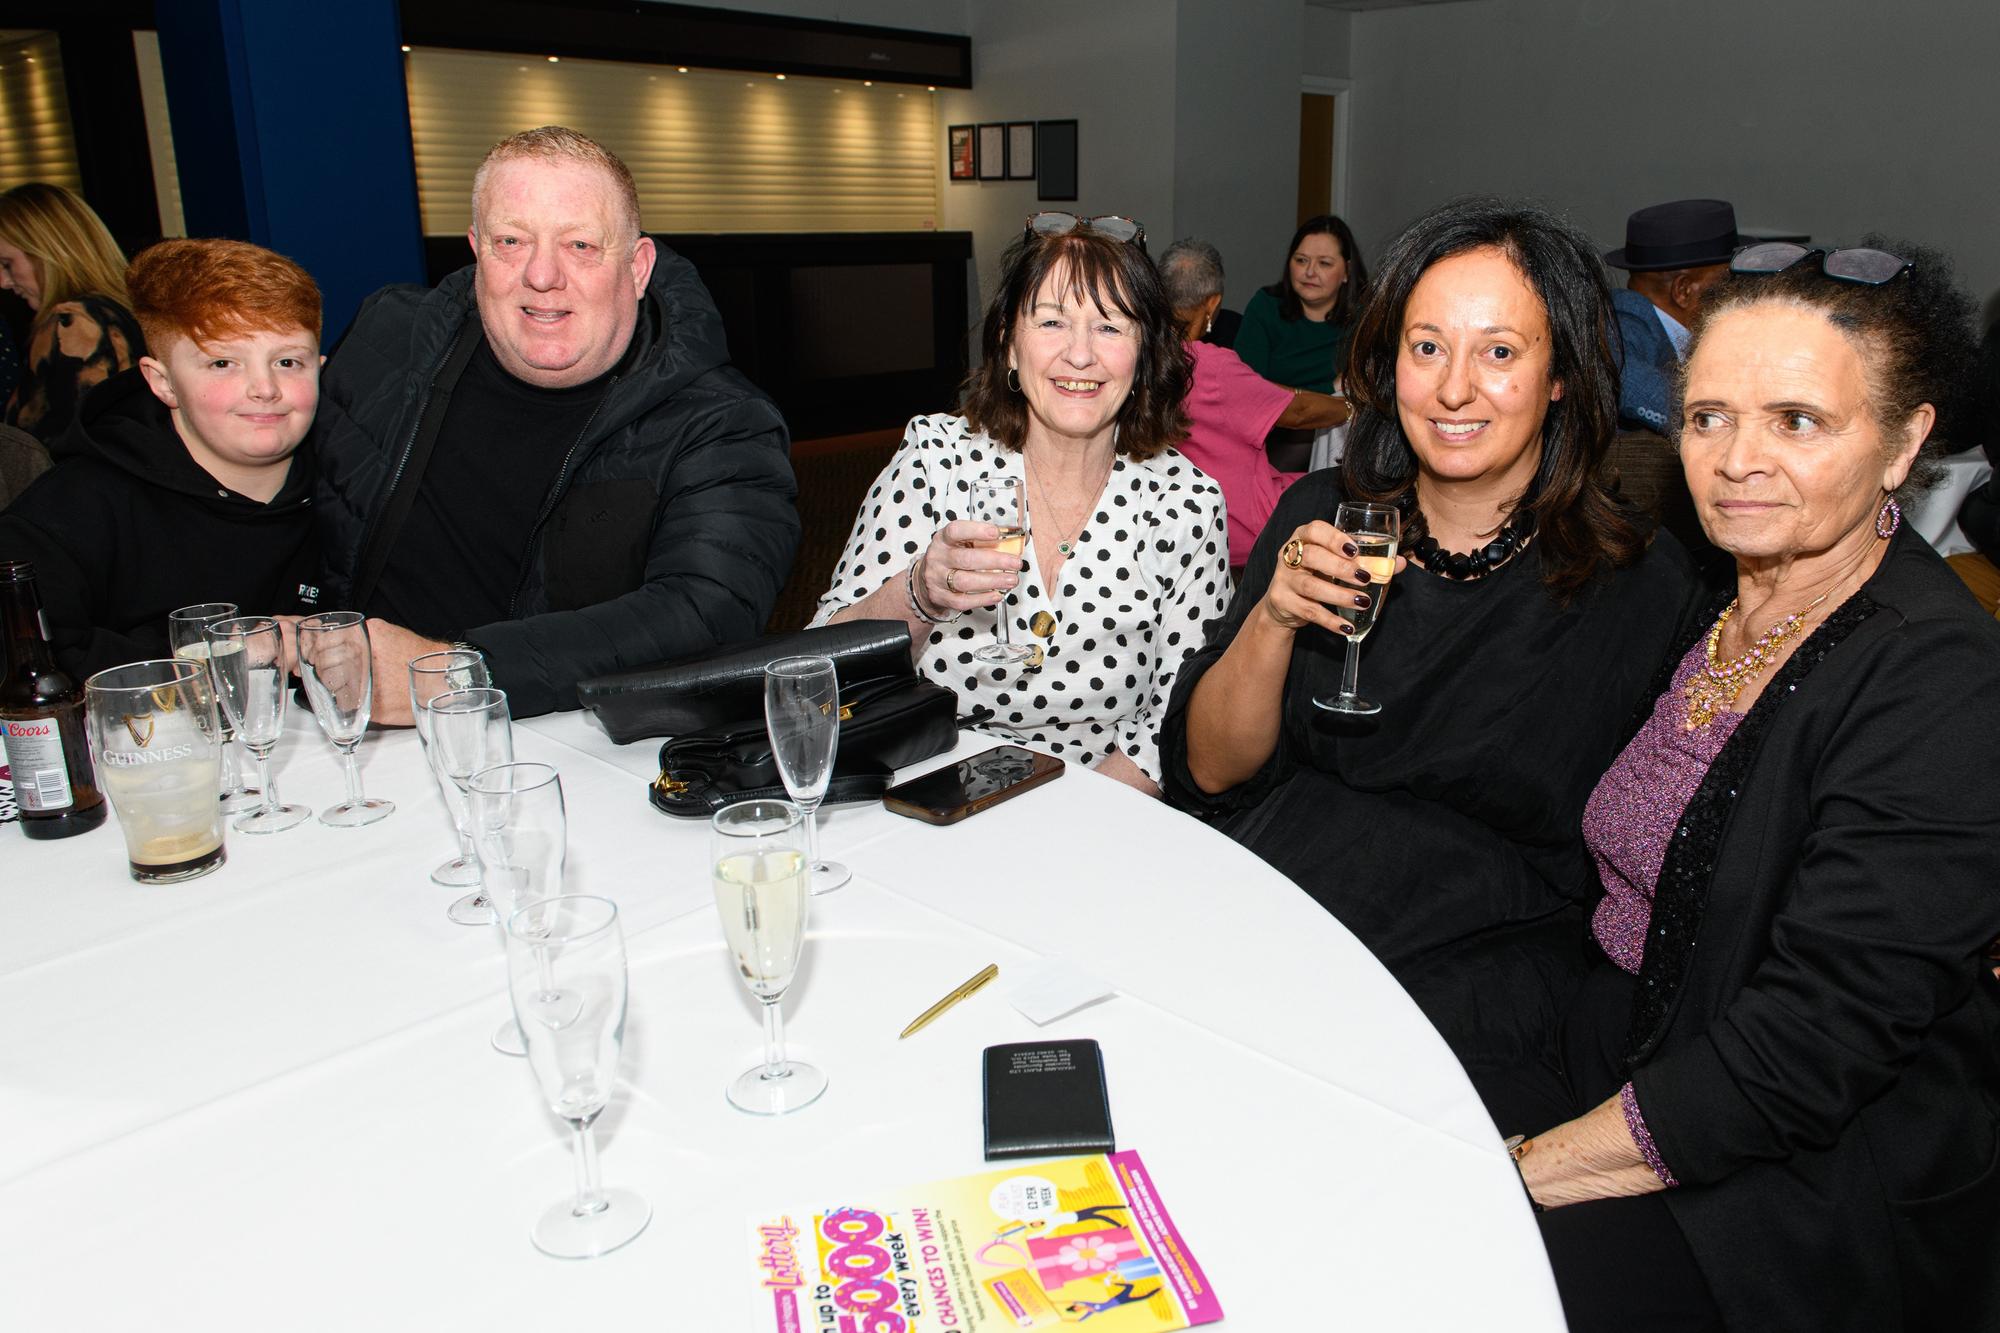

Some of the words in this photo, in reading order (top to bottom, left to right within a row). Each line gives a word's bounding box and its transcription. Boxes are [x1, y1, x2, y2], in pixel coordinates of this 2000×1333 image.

[9, 723, 50, 736] Coors
[102, 743, 192, 767] GUINNESS
[1041, 1187, 1052, 1207] WEEK
[912, 1208, 934, 1242] WIN!
[760, 1216, 803, 1286] Lottery
[886, 1233, 909, 1272] week
[922, 1246, 940, 1264] TO
[815, 1285, 830, 1300] to
[899, 1278, 920, 1317] every
[927, 1267, 958, 1326] CHANCES
[820, 1305, 837, 1323] up
